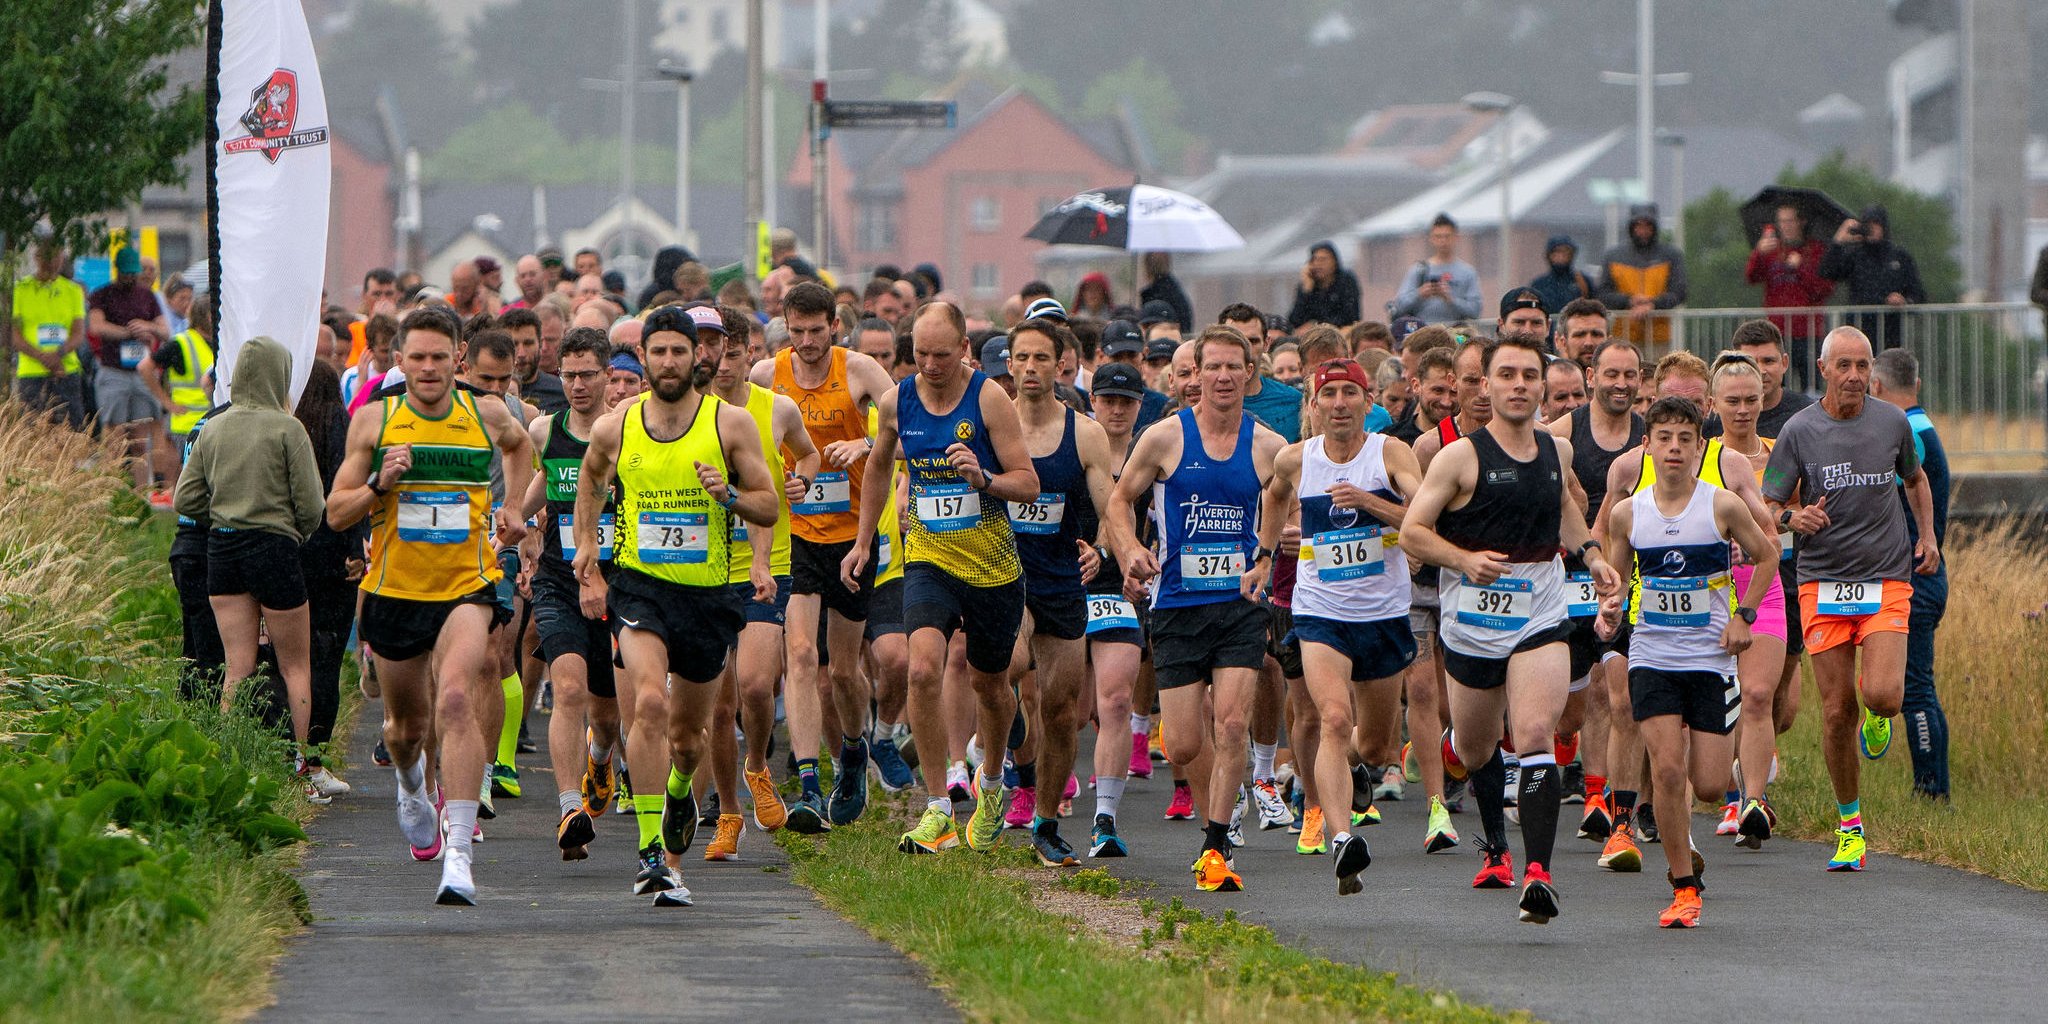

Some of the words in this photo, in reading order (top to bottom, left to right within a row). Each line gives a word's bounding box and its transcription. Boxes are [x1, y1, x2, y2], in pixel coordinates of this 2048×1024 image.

[293, 131, 322, 145] TRUST
[412, 451, 474, 468] ORNWALL
[911, 458, 930, 468] AXE
[558, 467, 577, 480] VE
[1822, 462, 1851, 478] THE
[558, 483, 578, 492] RUN
[638, 490, 672, 499] SOUTH
[675, 487, 703, 497] WEST
[637, 501, 660, 509] ROAD
[663, 499, 710, 509] RUNNERS
[935, 497, 963, 517] 157
[1017, 503, 1048, 521] 295
[432, 506, 437, 527] 1
[661, 527, 684, 547] 73
[1331, 542, 1367, 565] 316
[1198, 555, 1231, 576] 374
[1834, 583, 1865, 602] 230
[1092, 600, 1122, 617] 396
[1477, 590, 1513, 614] 392
[1657, 592, 1692, 613] 318
